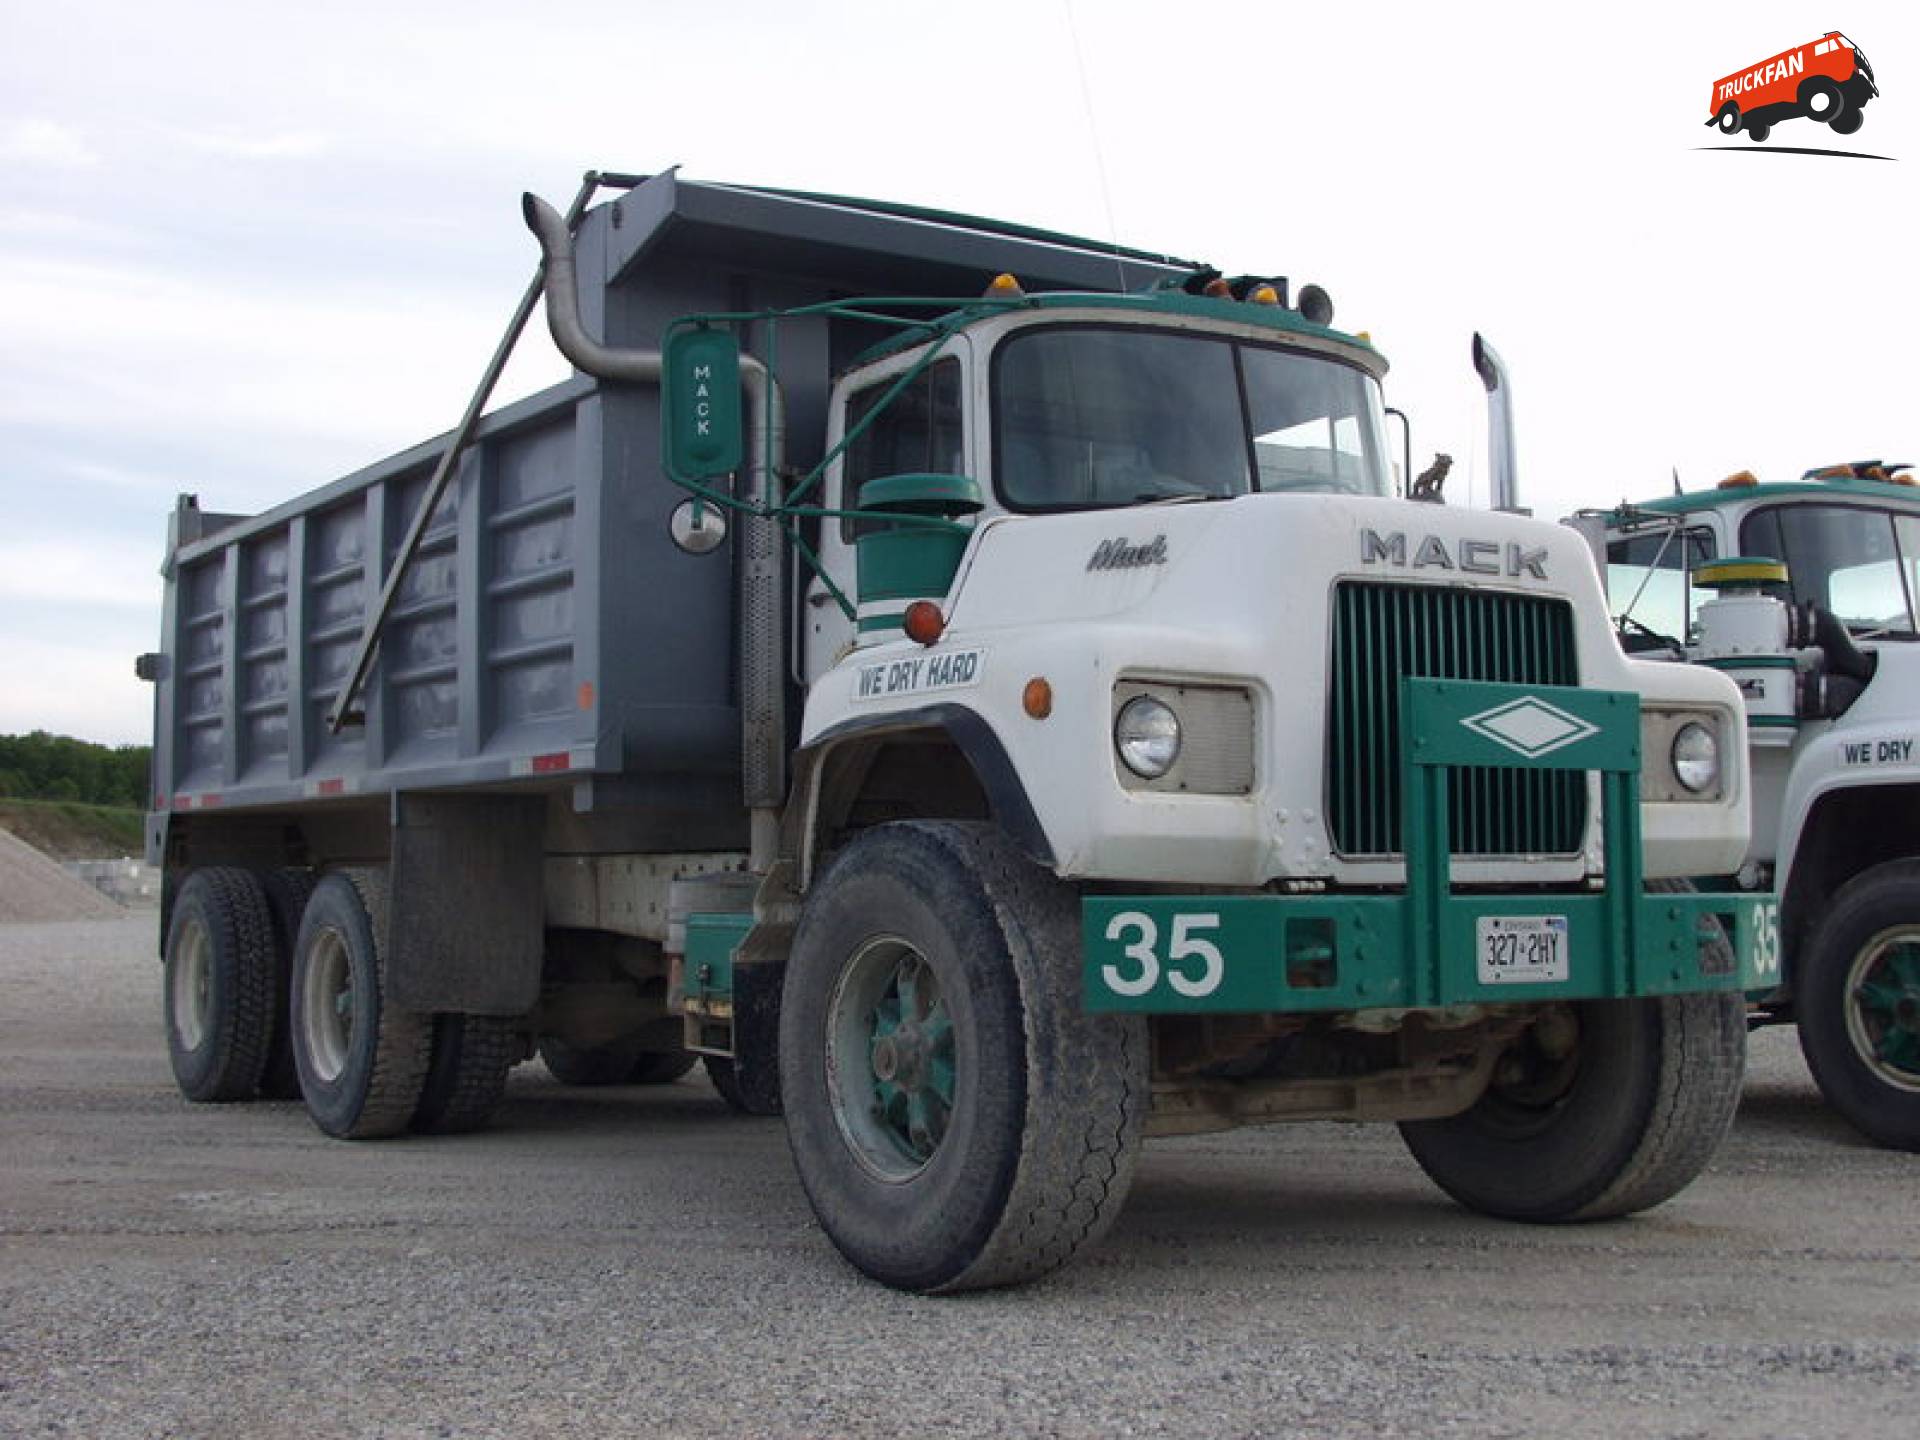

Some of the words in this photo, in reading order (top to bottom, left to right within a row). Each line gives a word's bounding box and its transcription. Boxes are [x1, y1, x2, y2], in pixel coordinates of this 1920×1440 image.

[694, 365, 711, 436] MACK
[1360, 528, 1548, 580] MACK
[859, 666, 884, 696] WE
[887, 659, 924, 692] DRY
[926, 652, 977, 687] HARD
[1845, 743, 1871, 764] WE
[1878, 740, 1913, 762] DRY
[1102, 911, 1224, 997] 35
[1752, 904, 1779, 975] 35
